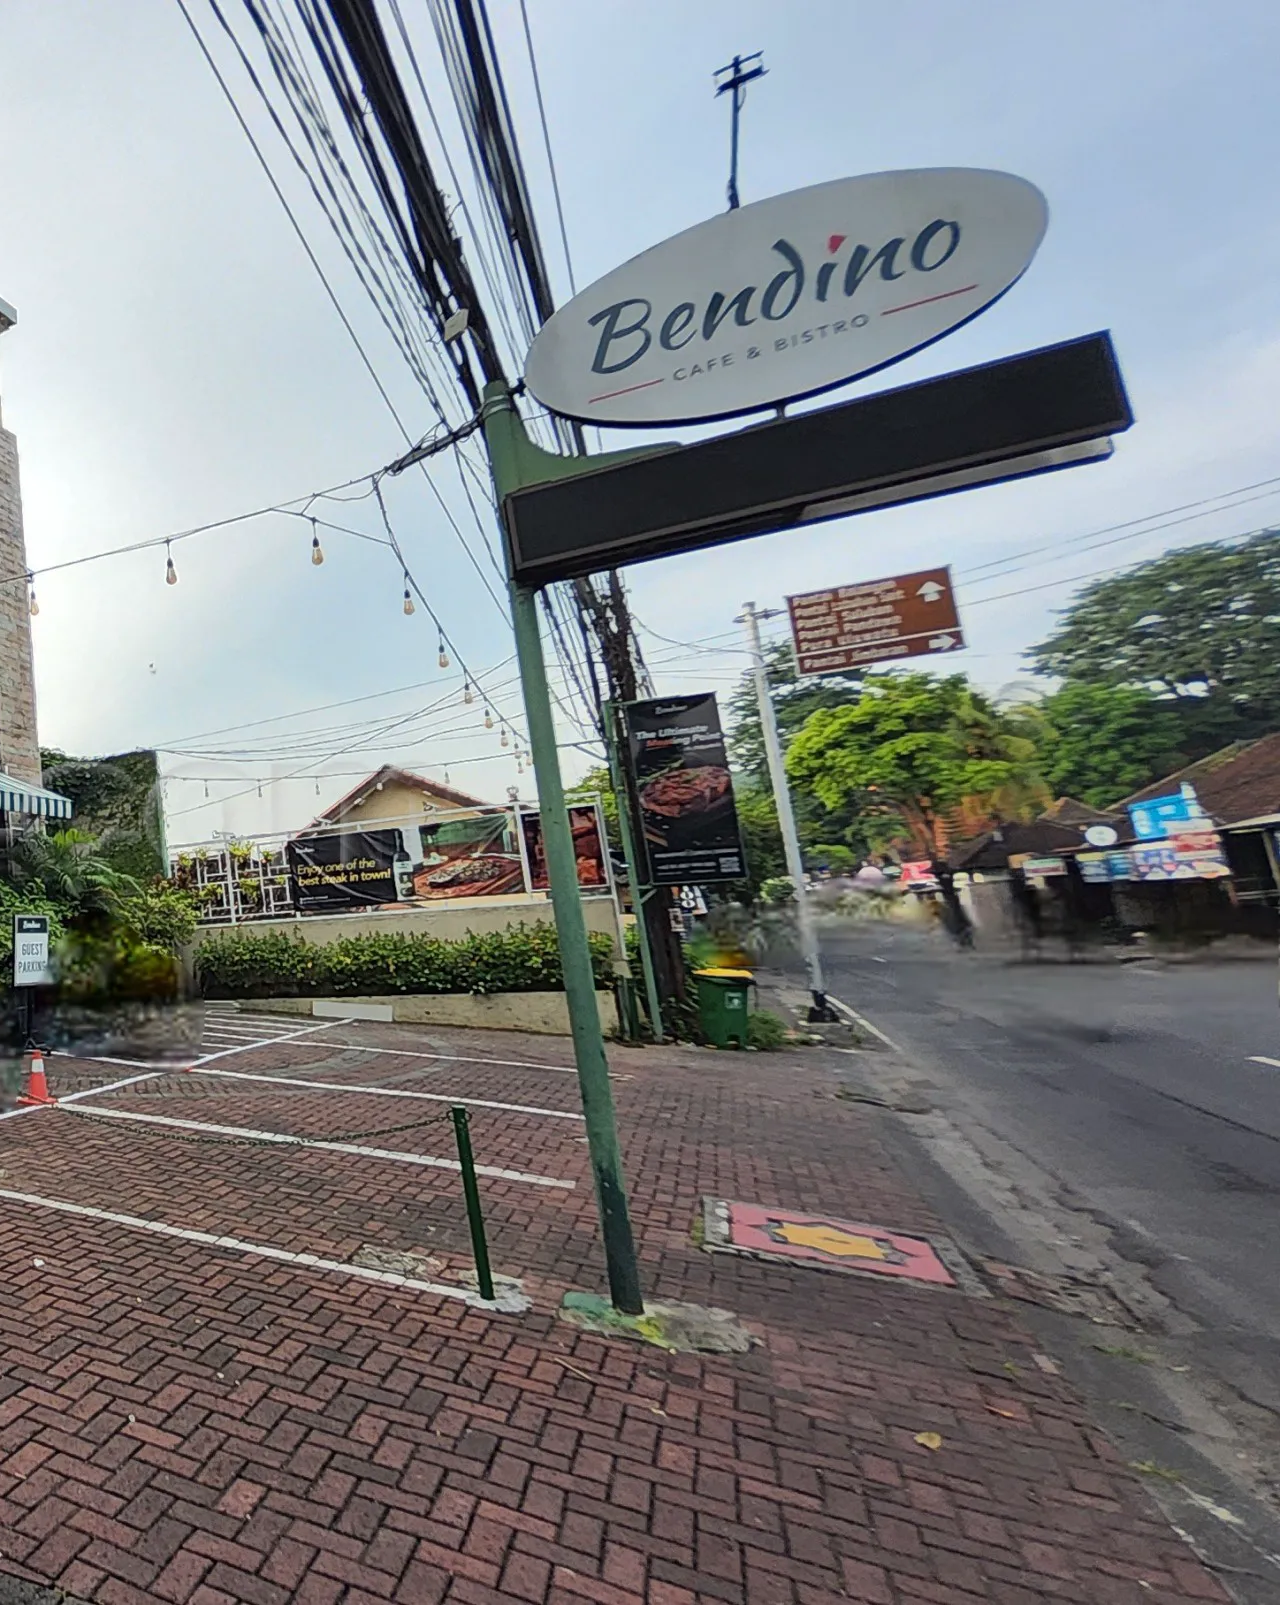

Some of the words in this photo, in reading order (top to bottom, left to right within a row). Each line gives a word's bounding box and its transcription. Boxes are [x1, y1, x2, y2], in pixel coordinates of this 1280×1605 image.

[587, 218, 962, 375] Bendino
[673, 352, 737, 382] CAFE
[746, 345, 761, 360] &
[774, 313, 871, 352] BISTRO
[297, 863, 325, 877] Enjoy
[325, 863, 345, 873] one
[346, 858, 357, 870] of
[358, 857, 376, 869] the
[298, 875, 320, 887] best
[321, 871, 348, 885] steak
[349, 870, 359, 882] in
[361, 868, 392, 882] town!
[21, 943, 44, 956] GUEST
